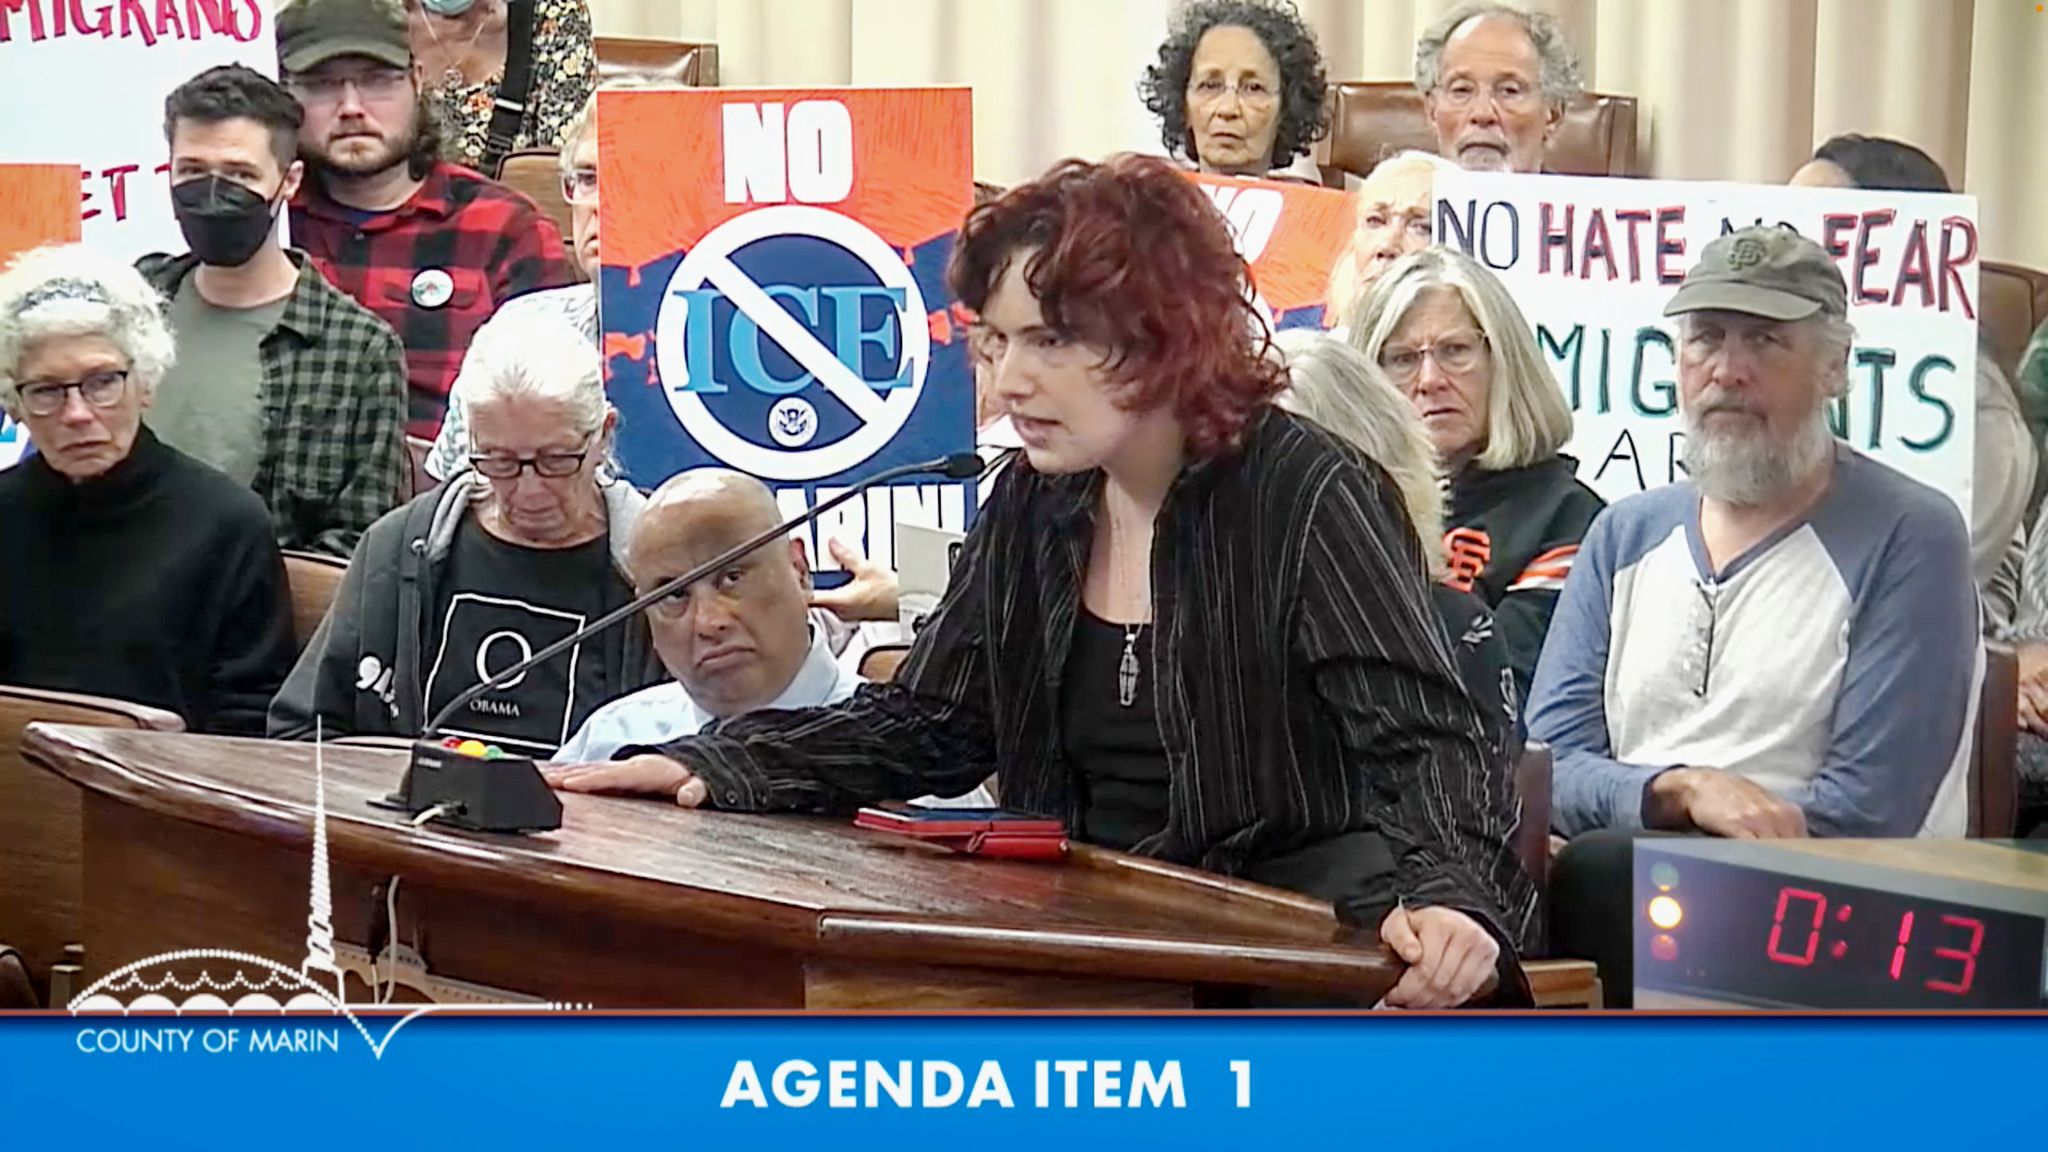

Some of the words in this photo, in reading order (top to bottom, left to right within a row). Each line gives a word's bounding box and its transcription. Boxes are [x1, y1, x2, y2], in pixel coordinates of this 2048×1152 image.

[722, 100, 853, 203] NO
[1437, 198, 1519, 270] NO
[1538, 202, 1686, 285] HATE
[1823, 208, 1979, 320] FEAR
[673, 284, 914, 393] ICE
[469, 698, 520, 718] OBAMA
[476, 630, 532, 690] O
[1766, 886, 1986, 996] 0:13
